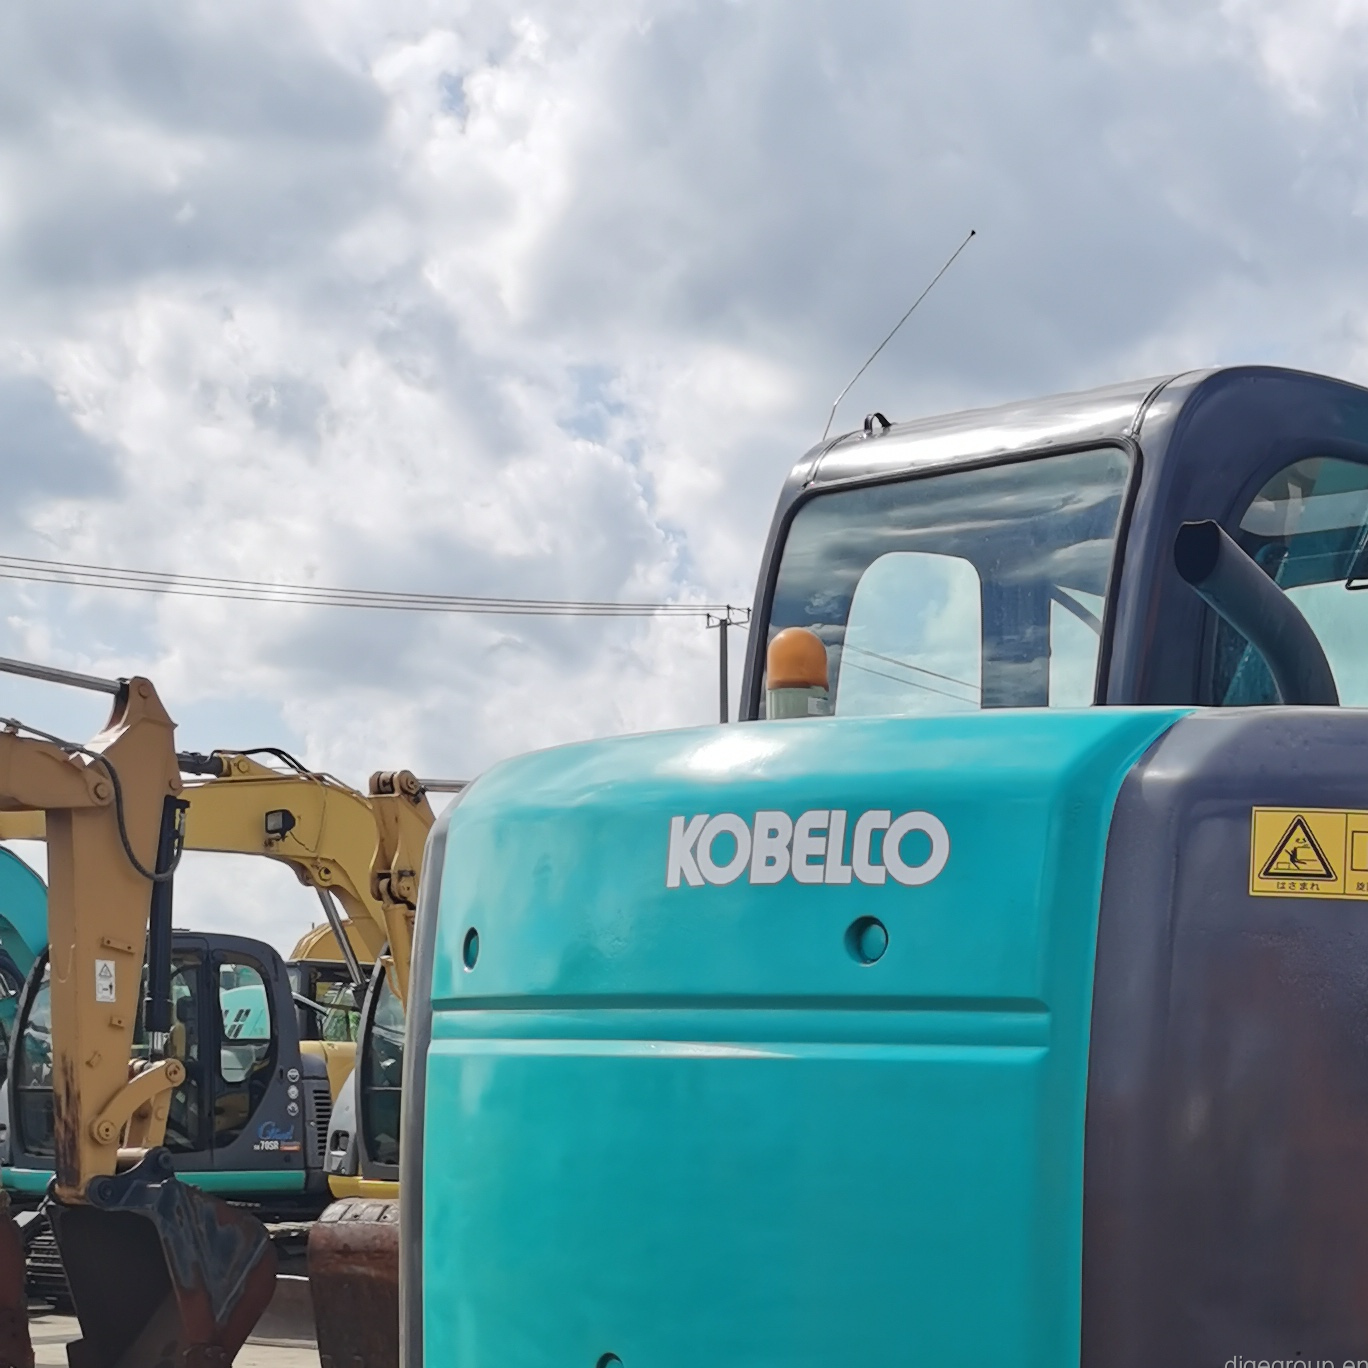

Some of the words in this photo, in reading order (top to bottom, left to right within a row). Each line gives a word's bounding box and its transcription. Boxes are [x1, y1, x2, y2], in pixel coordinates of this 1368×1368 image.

[665, 809, 951, 888] KOBELCO
[1276, 881, 1320, 891] はさまれ
